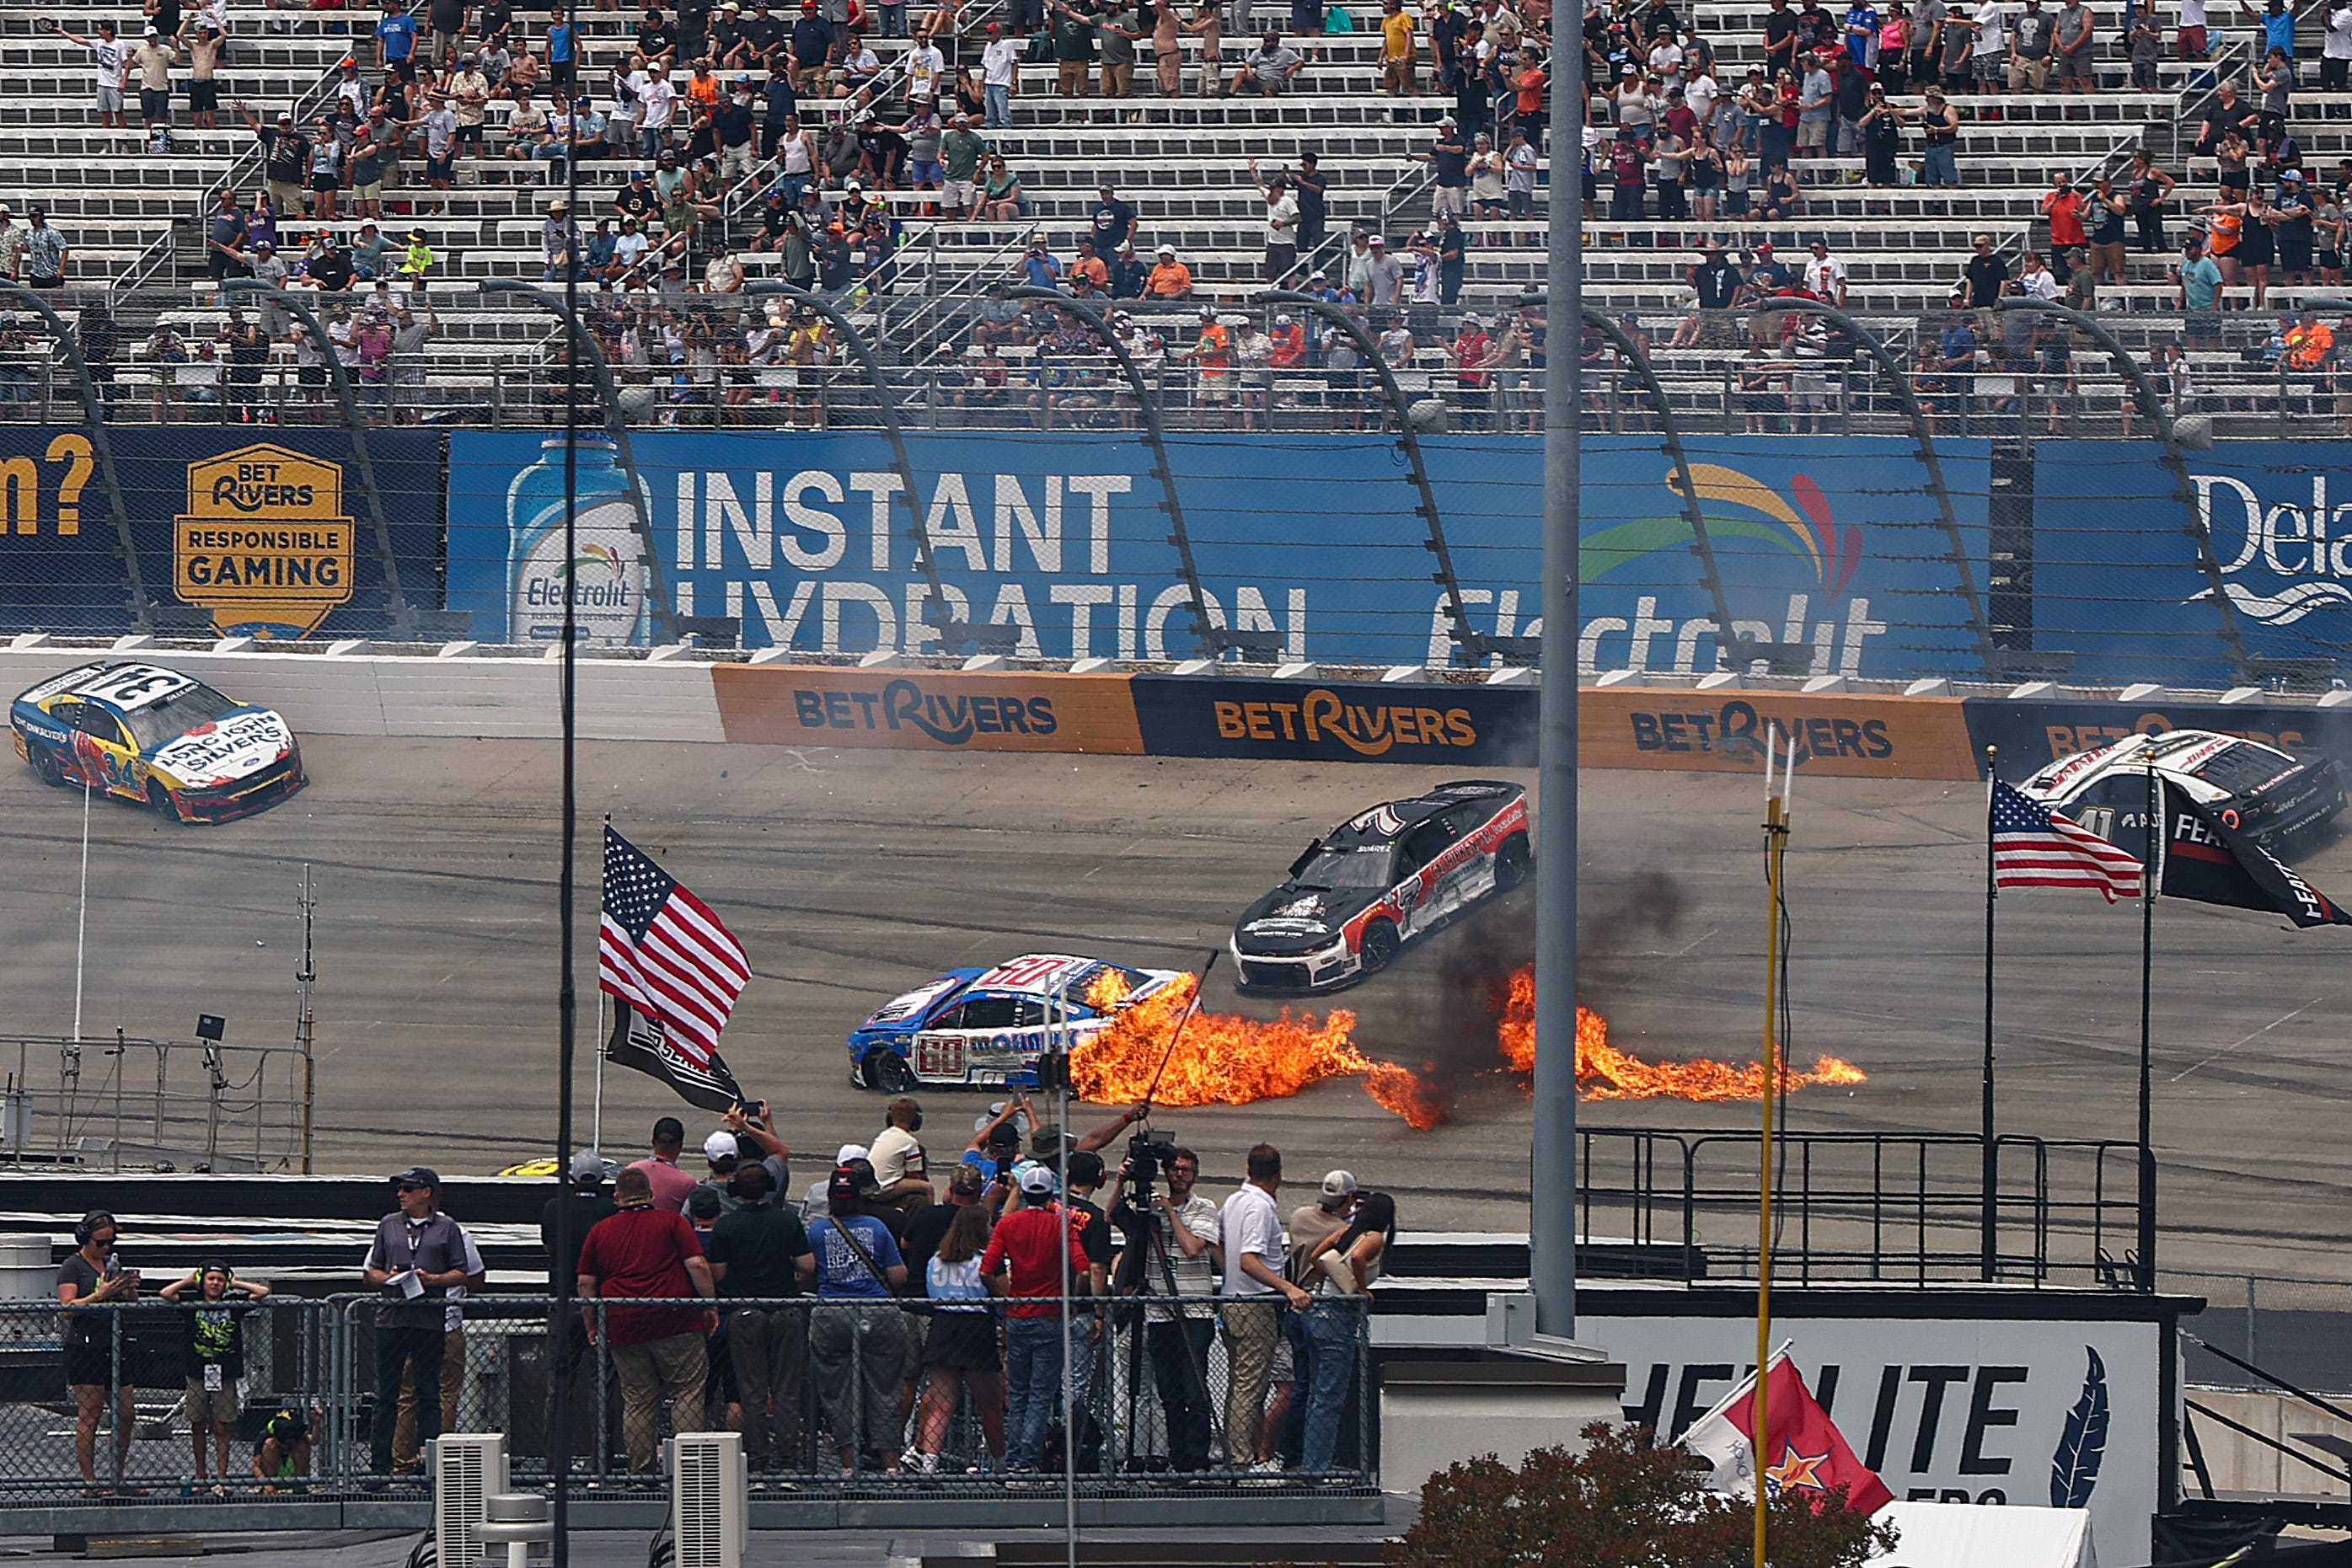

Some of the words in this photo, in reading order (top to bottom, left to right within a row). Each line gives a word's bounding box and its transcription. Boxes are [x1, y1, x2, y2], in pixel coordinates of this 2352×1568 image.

[212, 474, 313, 512] RIVERS
[238, 463, 281, 484] BET
[188, 531, 339, 549] RESPONSIBLE
[677, 470, 1132, 574] INSTANT
[187, 554, 339, 586] GAMING
[793, 678, 1058, 746] BETRIVERS
[1214, 688, 1478, 756] BETRIVERS
[161, 736, 221, 768] LONG
[221, 715, 278, 738] JOHN
[186, 725, 282, 772] SILVER'S
[102, 751, 137, 791] 34
[918, 1037, 964, 1076] 60
